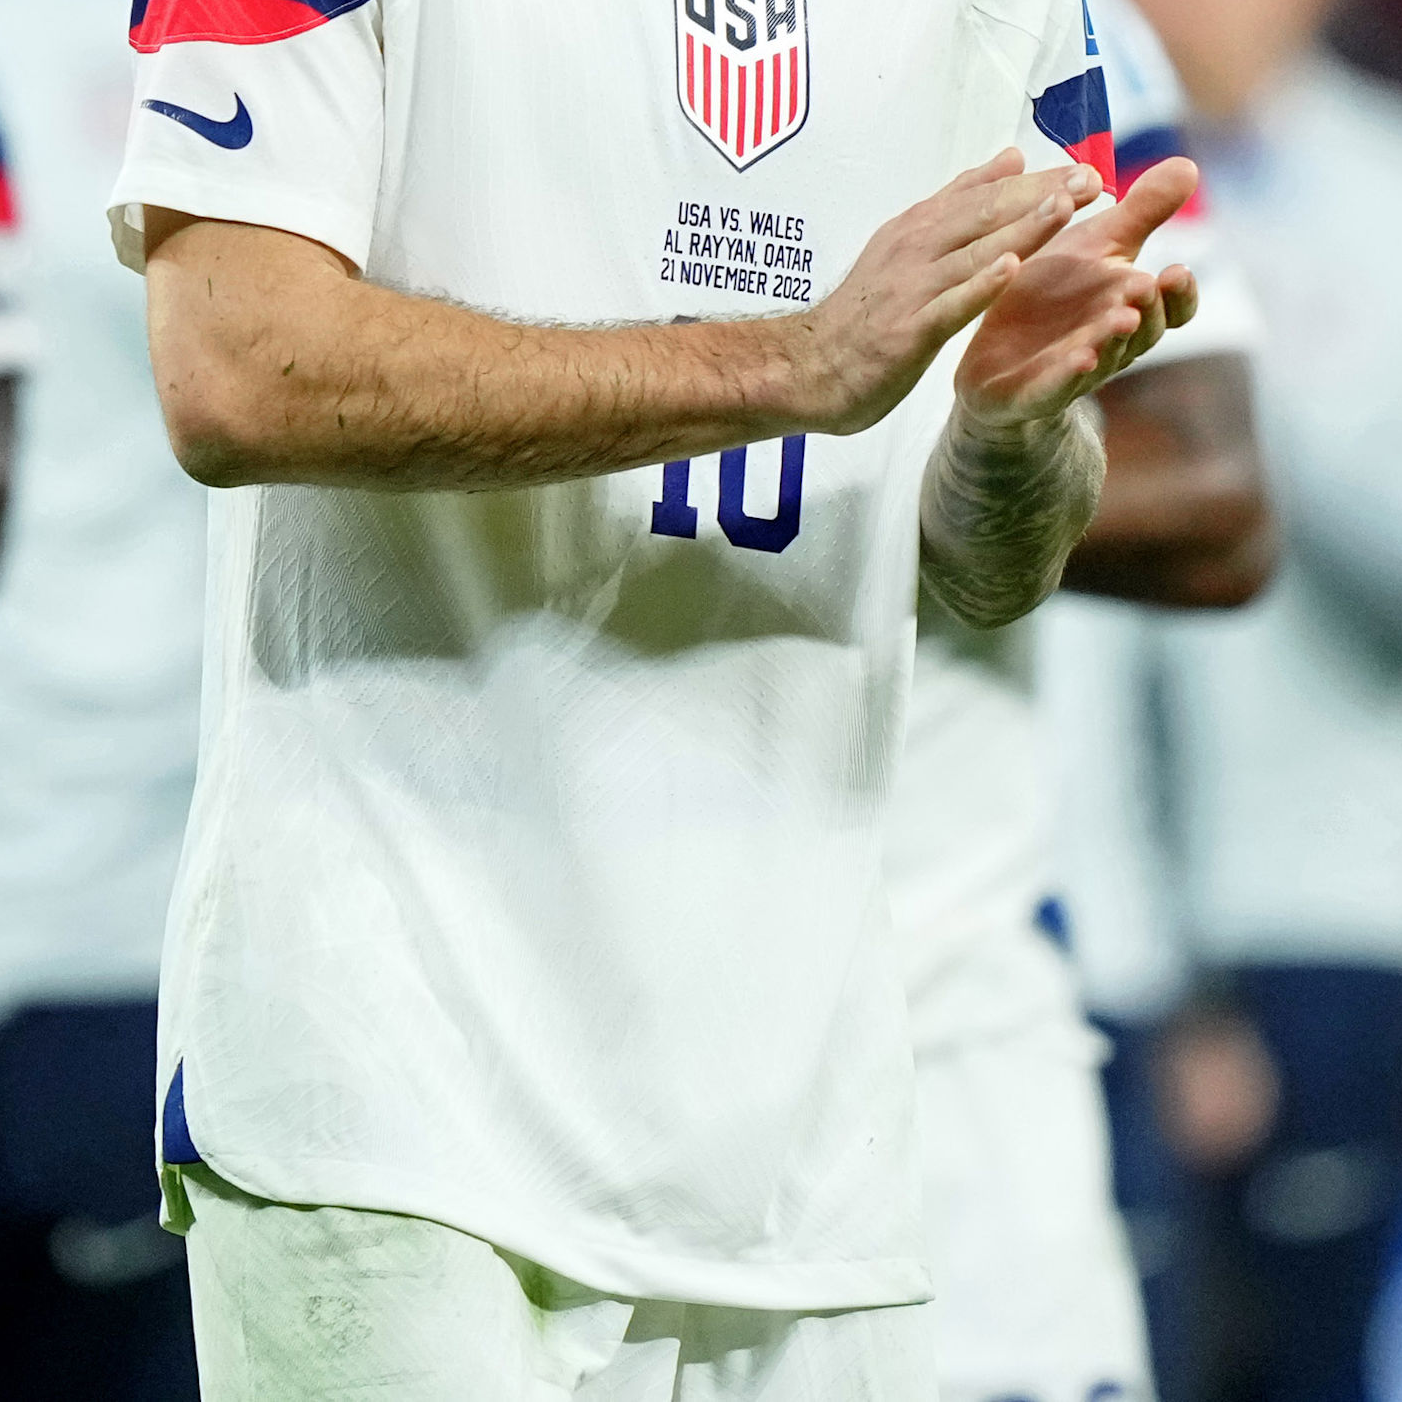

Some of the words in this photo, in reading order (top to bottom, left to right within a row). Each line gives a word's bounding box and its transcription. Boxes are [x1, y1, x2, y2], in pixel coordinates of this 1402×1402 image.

[677, 201, 712, 229] USA
[719, 206, 743, 233] VS.
[750, 210, 805, 242] WALES
[663, 228, 683, 255] AL
[688, 232, 758, 267] RAYYAN,
[763, 242, 813, 274] QATAR
[660, 257, 675, 283] 21
[679, 260, 768, 296] NOVEMBER
[772, 273, 812, 303] 2022
